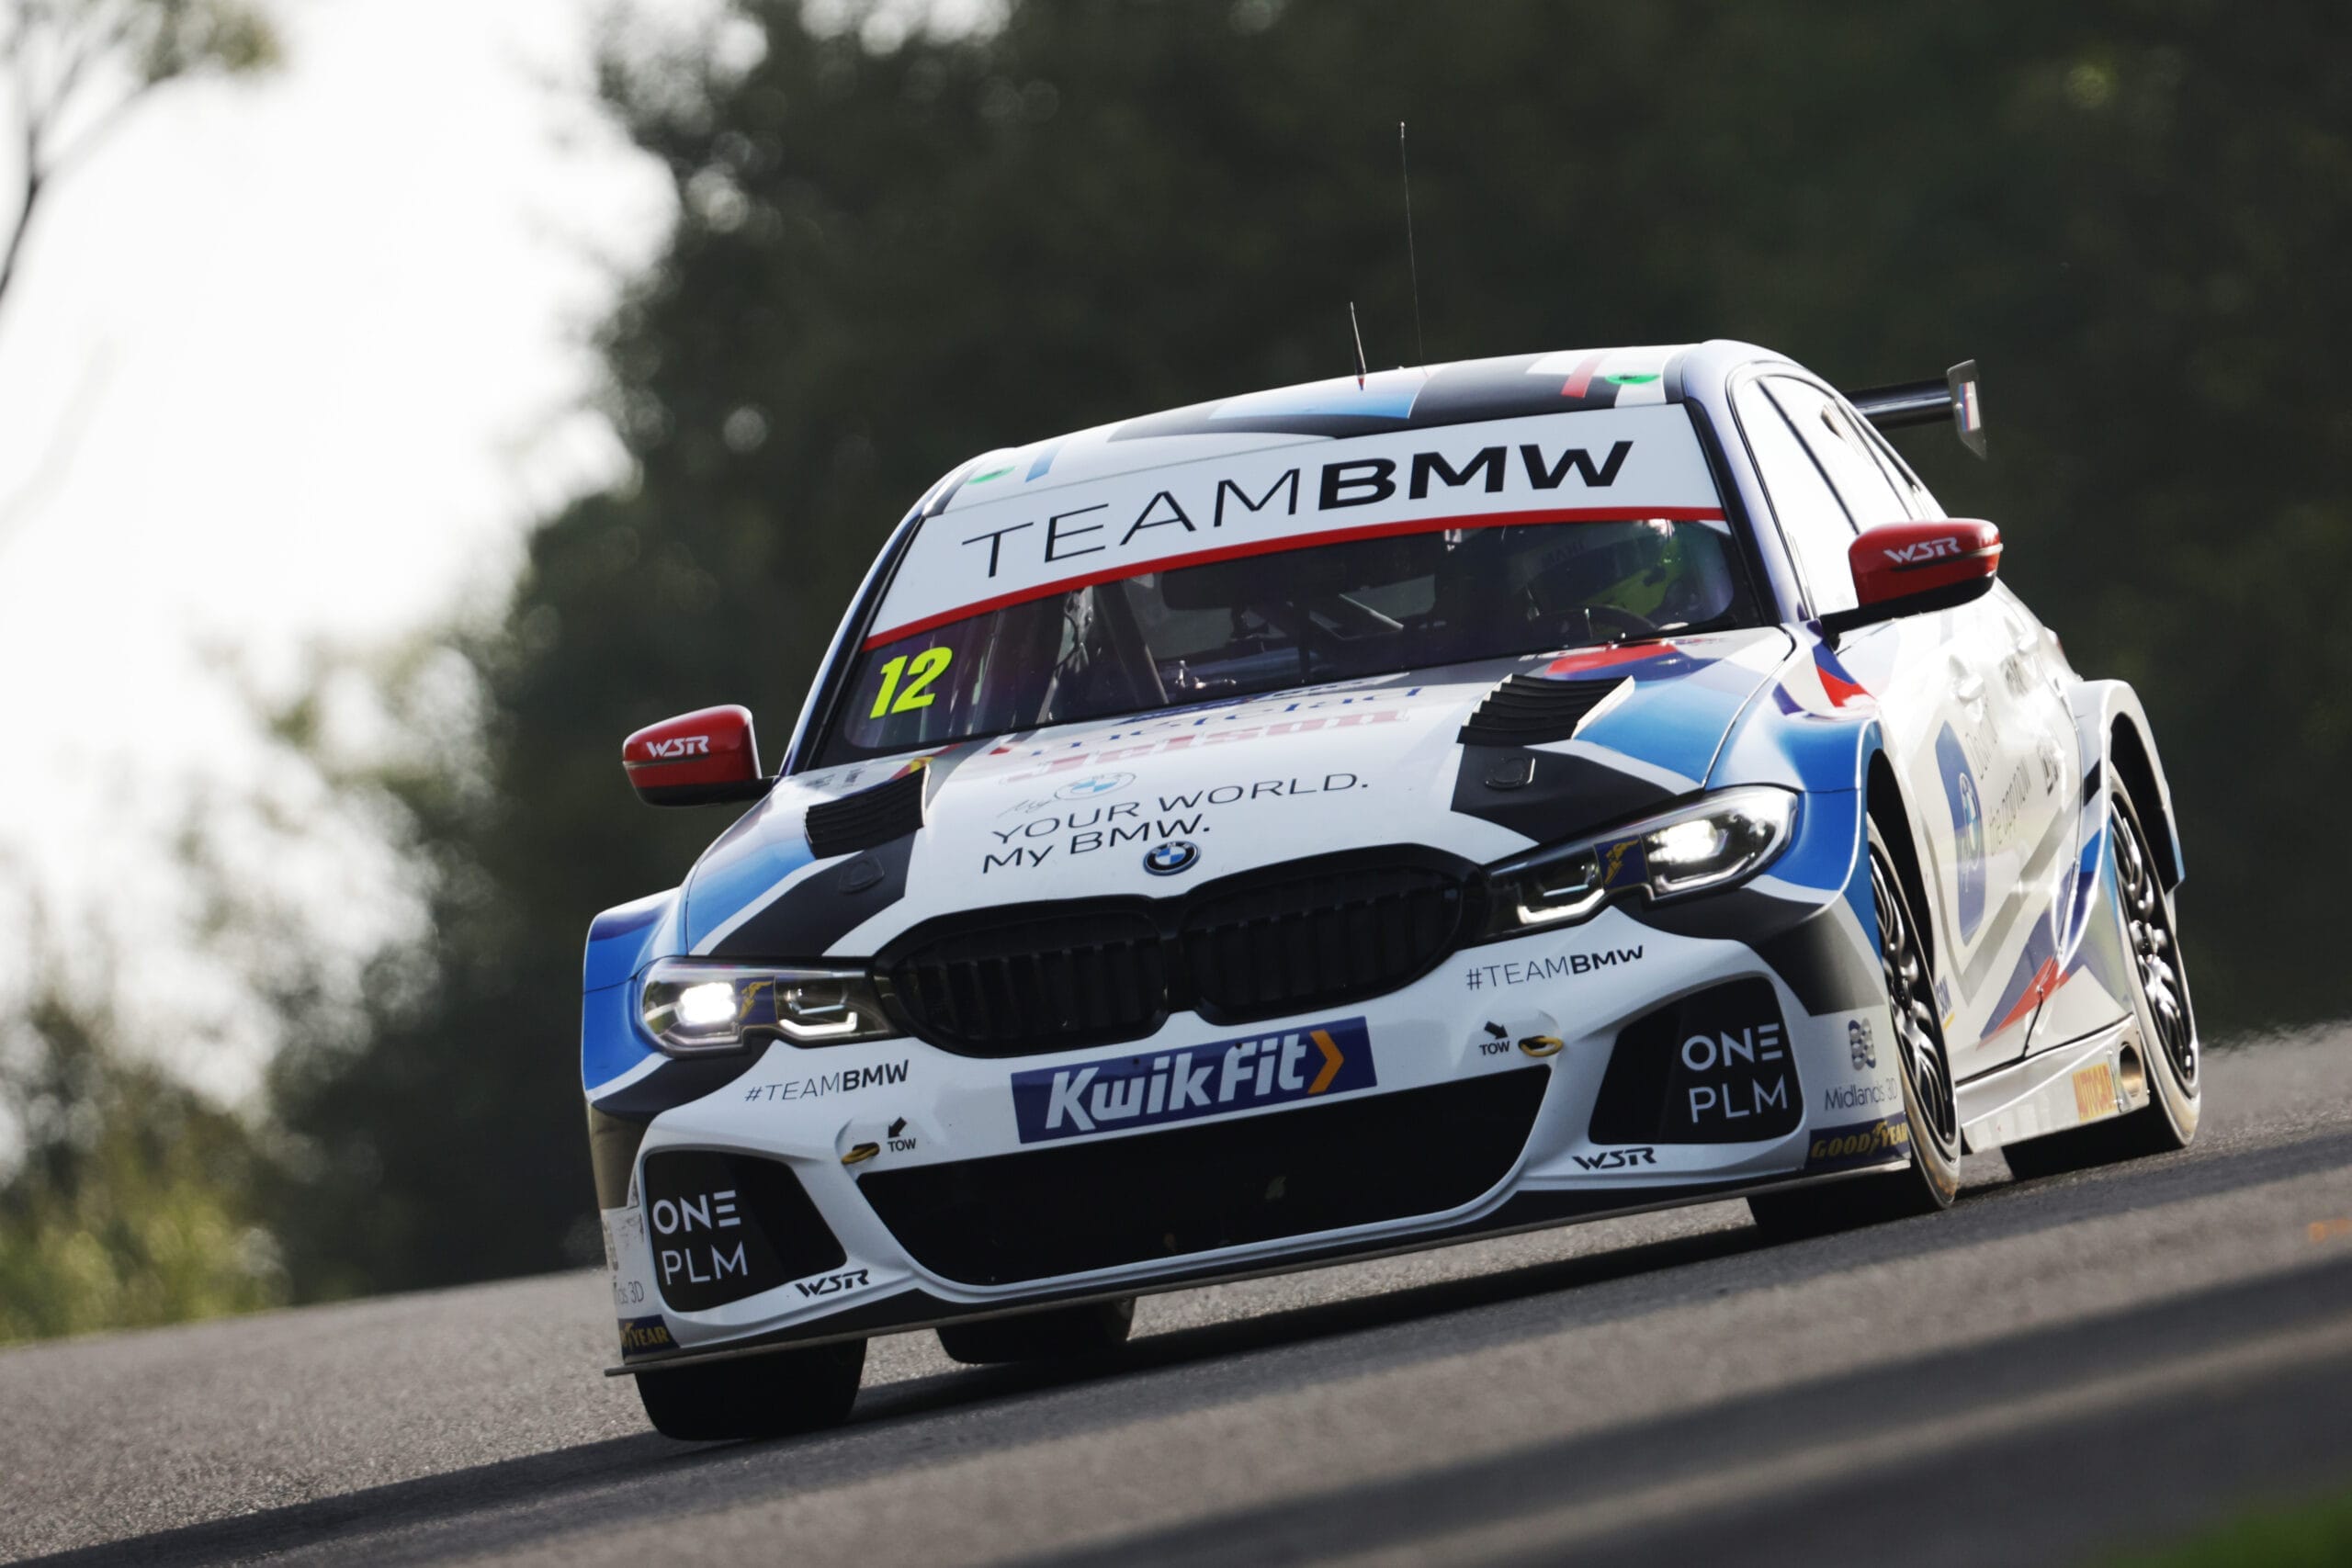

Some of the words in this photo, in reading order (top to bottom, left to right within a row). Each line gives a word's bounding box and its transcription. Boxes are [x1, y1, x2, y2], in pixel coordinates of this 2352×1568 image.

[962, 441, 1634, 578] TEAMBMW
[1883, 536, 1962, 563] WSR
[868, 646, 953, 720] 12
[647, 736, 709, 758] WSR
[993, 801, 1140, 844] YOUR
[1159, 773, 1369, 813] WORLD.
[982, 844, 1054, 874] My
[1071, 813, 1210, 855] BMW.
[1466, 945, 1644, 990] #TEAMBMW
[1479, 1041, 1510, 1055] TOW
[1681, 1022, 1782, 1072] ONE
[744, 1059, 909, 1102] #TEAMBMW
[1689, 1076, 1788, 1123] PLM
[1825, 1083, 1884, 1111] Midlands
[1885, 1077, 1898, 1101] 3D
[888, 1138, 916, 1152] TOW
[1572, 1146, 1657, 1170] WSR
[652, 1190, 741, 1235] ONE
[662, 1241, 748, 1287] PLM
[795, 1269, 869, 1298] WSR
[628, 1280, 644, 1303] 3D
